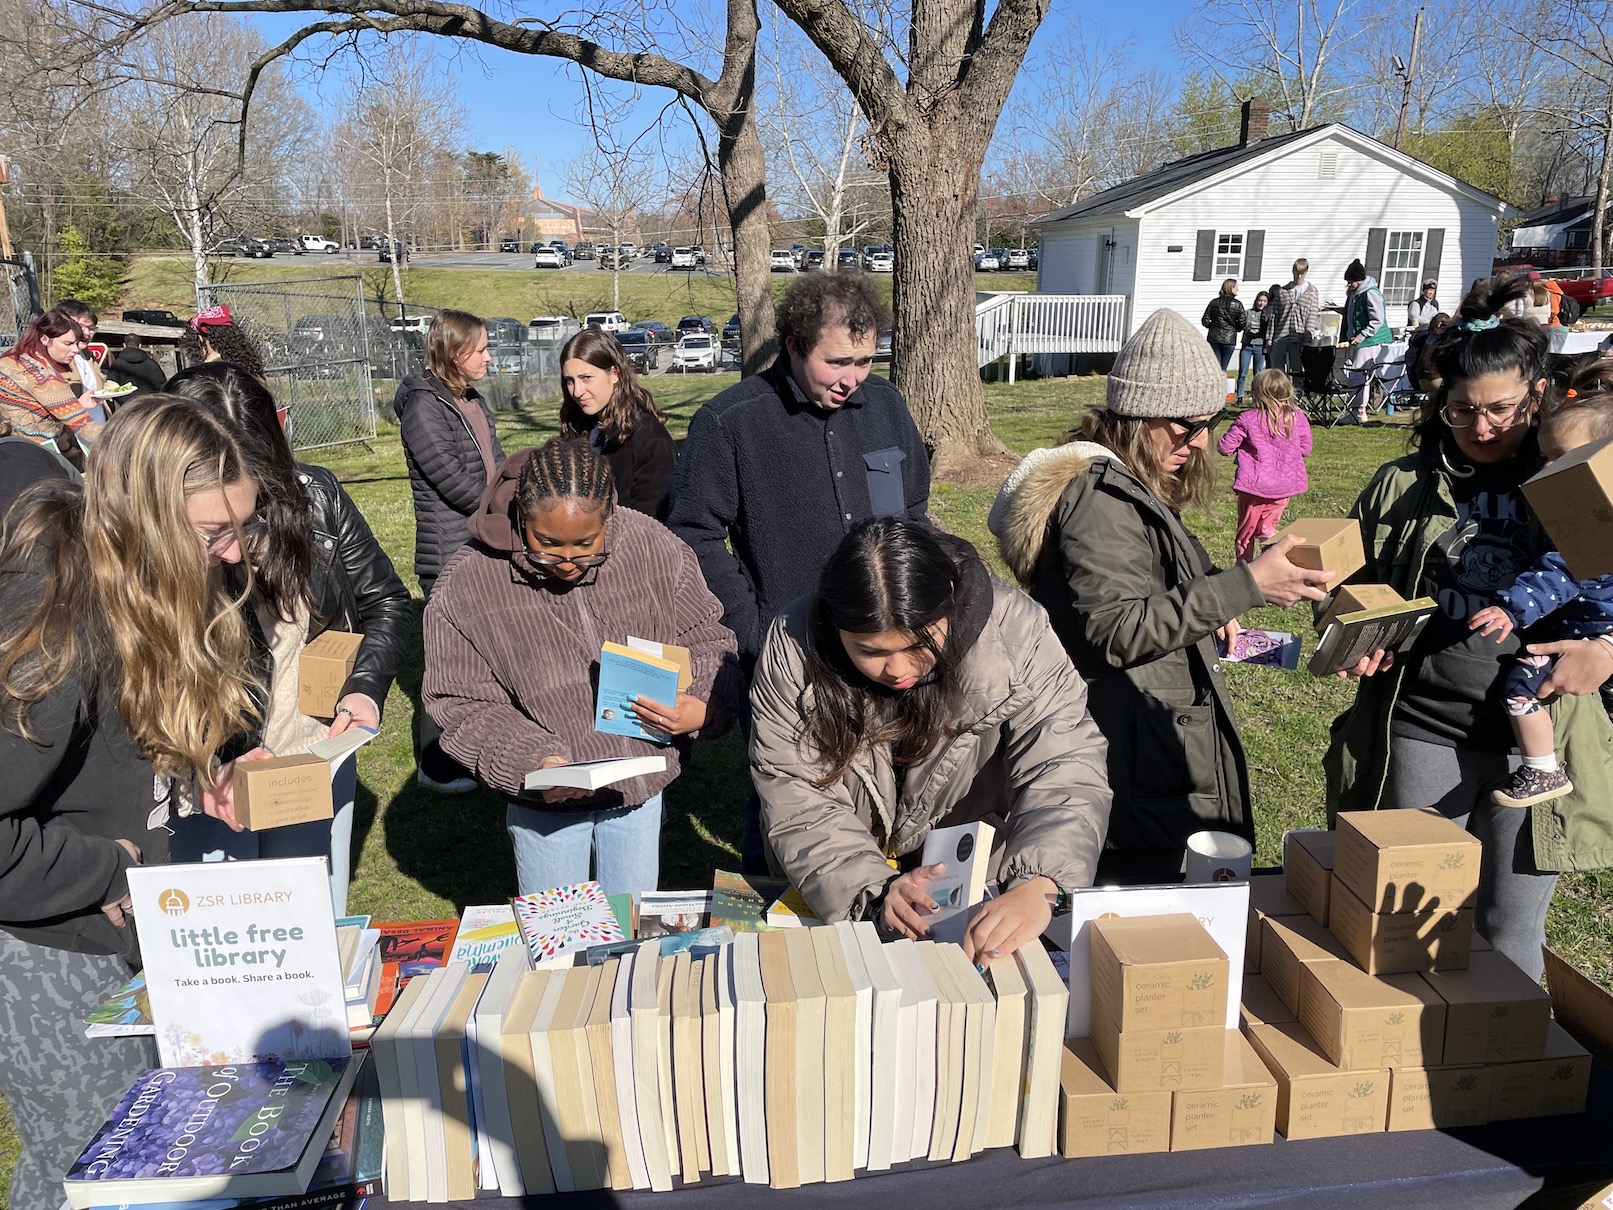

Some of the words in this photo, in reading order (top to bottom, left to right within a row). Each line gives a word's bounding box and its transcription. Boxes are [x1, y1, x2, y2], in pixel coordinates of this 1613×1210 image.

[268, 775, 313, 788] includes
[1390, 859, 1424, 868] ceramic
[1389, 871, 1419, 880] planter
[196, 895, 225, 908] ZSR
[230, 891, 293, 906] LIBRARY
[717, 901, 762, 910] THERN
[538, 904, 594, 920] Beginnings
[552, 912, 583, 924] Small
[552, 920, 590, 932] Garden
[170, 926, 239, 948] little
[246, 923, 304, 943] free
[194, 947, 287, 968] library
[174, 978, 200, 988] Take
[211, 975, 241, 985] book.
[242, 973, 274, 983] Share
[284, 970, 315, 980] book.
[1135, 982, 1172, 990] ceramic
[1135, 993, 1166, 1003] planter
[1135, 1006, 1148, 1014] set
[212, 1067, 239, 1082] of
[267, 1063, 310, 1098] THE
[1301, 1088, 1334, 1098] ceramic
[1186, 1101, 1220, 1110] ceramic
[1300, 1101, 1329, 1111] planter
[1185, 1112, 1215, 1121] planter
[1300, 1113, 1312, 1122] set
[86, 1071, 176, 1175] GARDENING
[157, 1082, 232, 1174] OUTDOOR
[1184, 1124, 1198, 1132] set
[230, 1103, 285, 1169] BOOK
[271, 1202, 298, 1210] THAN
[301, 1191, 346, 1206] AVERAGE
